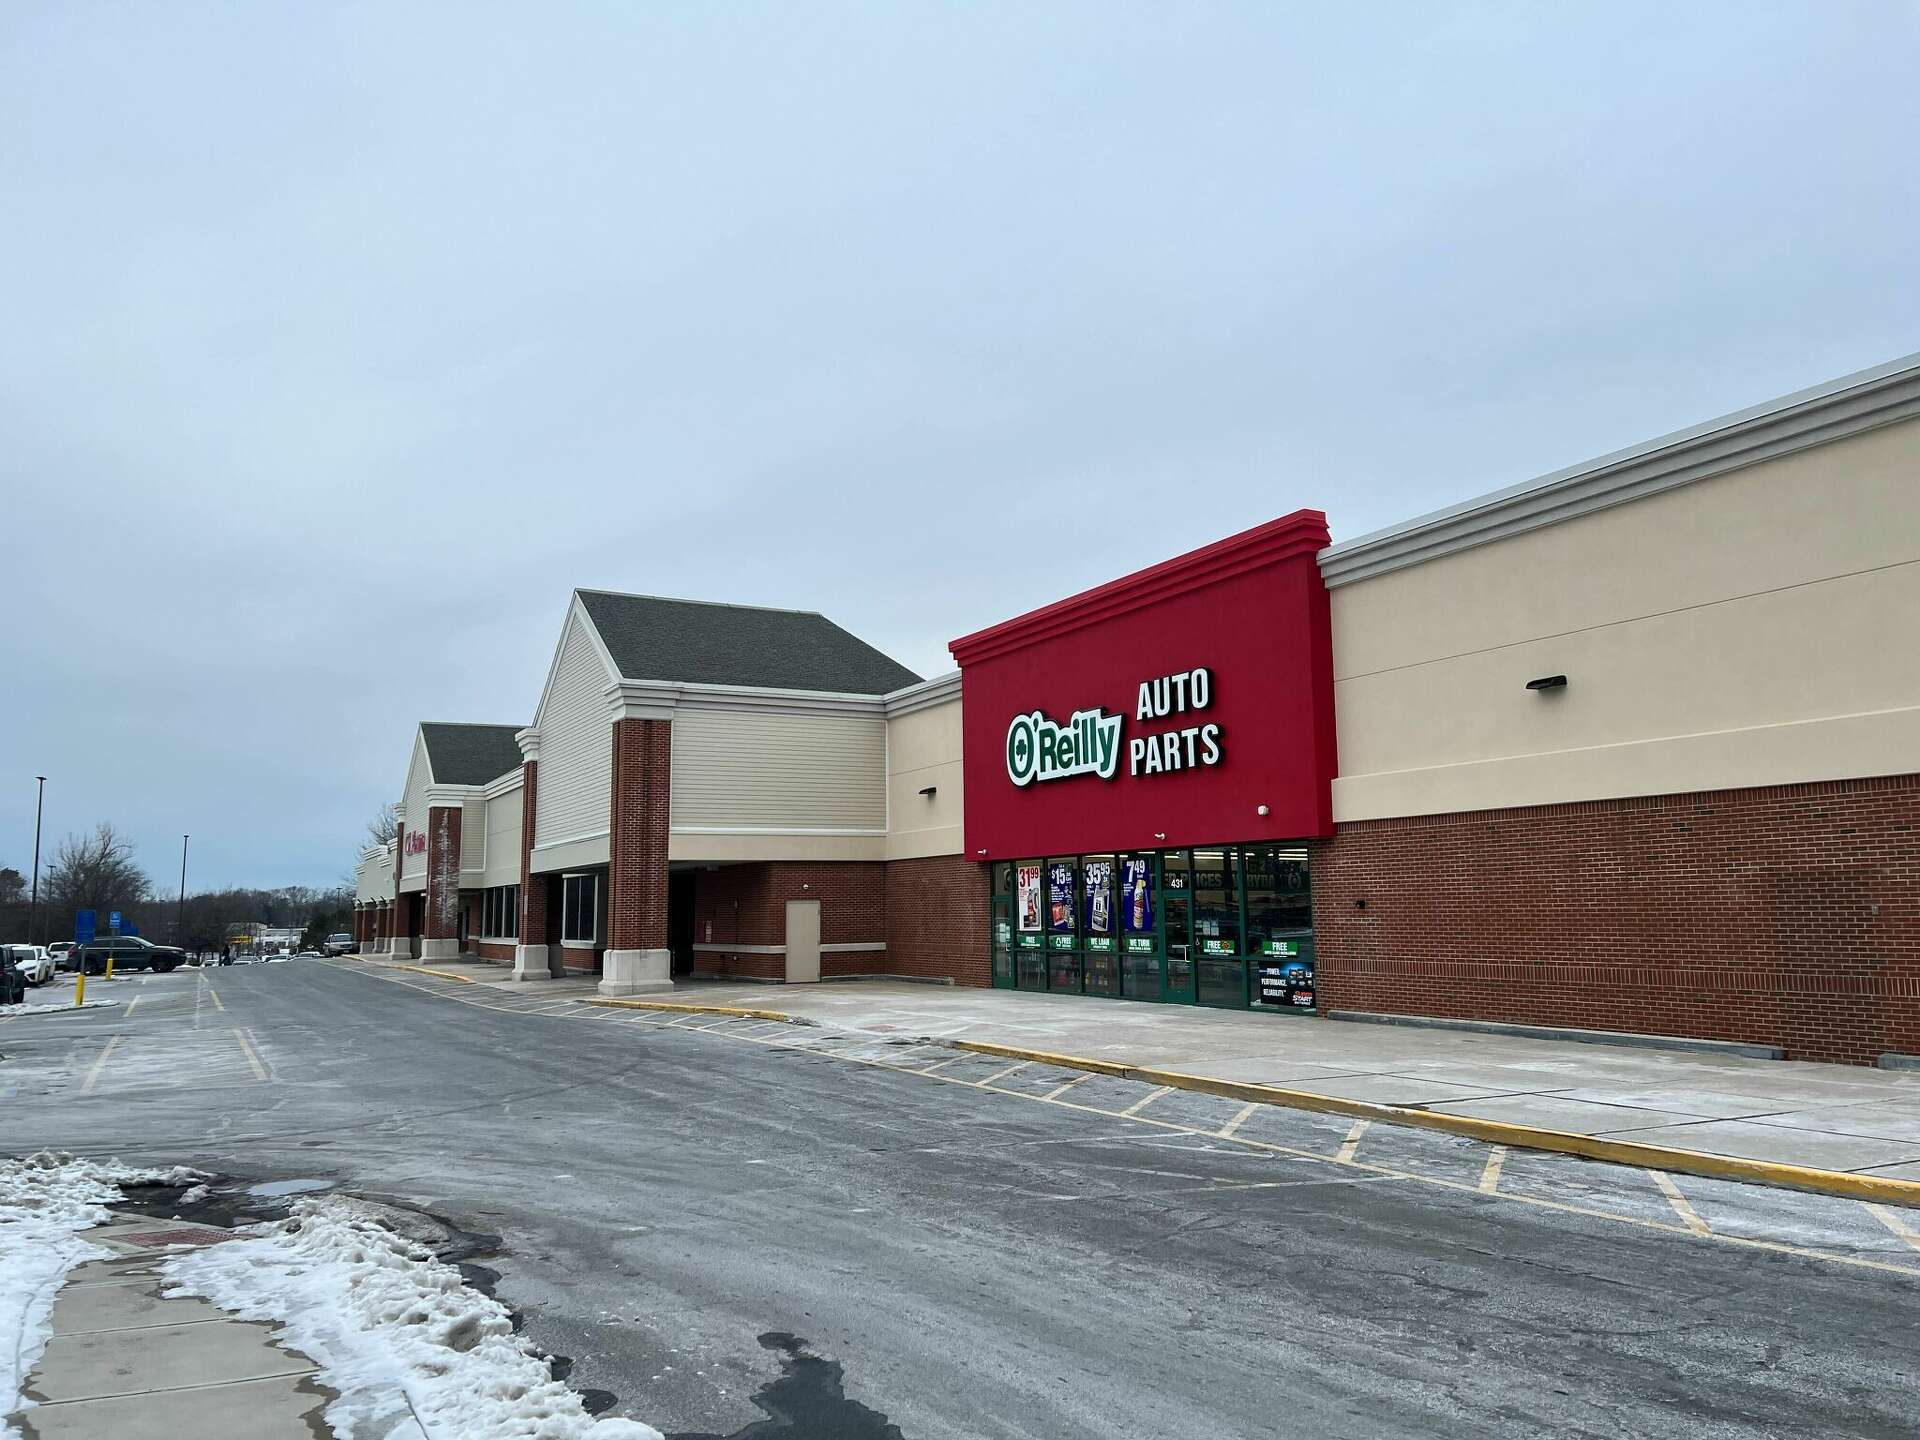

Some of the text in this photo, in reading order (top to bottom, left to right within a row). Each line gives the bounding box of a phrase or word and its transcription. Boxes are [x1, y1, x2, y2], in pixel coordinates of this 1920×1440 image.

[1136, 668, 1210, 721] AUTO
[1007, 717, 1117, 779] O'Reilly
[1130, 724, 1221, 776] PARTS
[1171, 879, 1183, 888] 431
[1062, 937, 1072, 945] FREE
[1207, 940, 1221, 949] FREE
[1272, 942, 1287, 951] FREE
